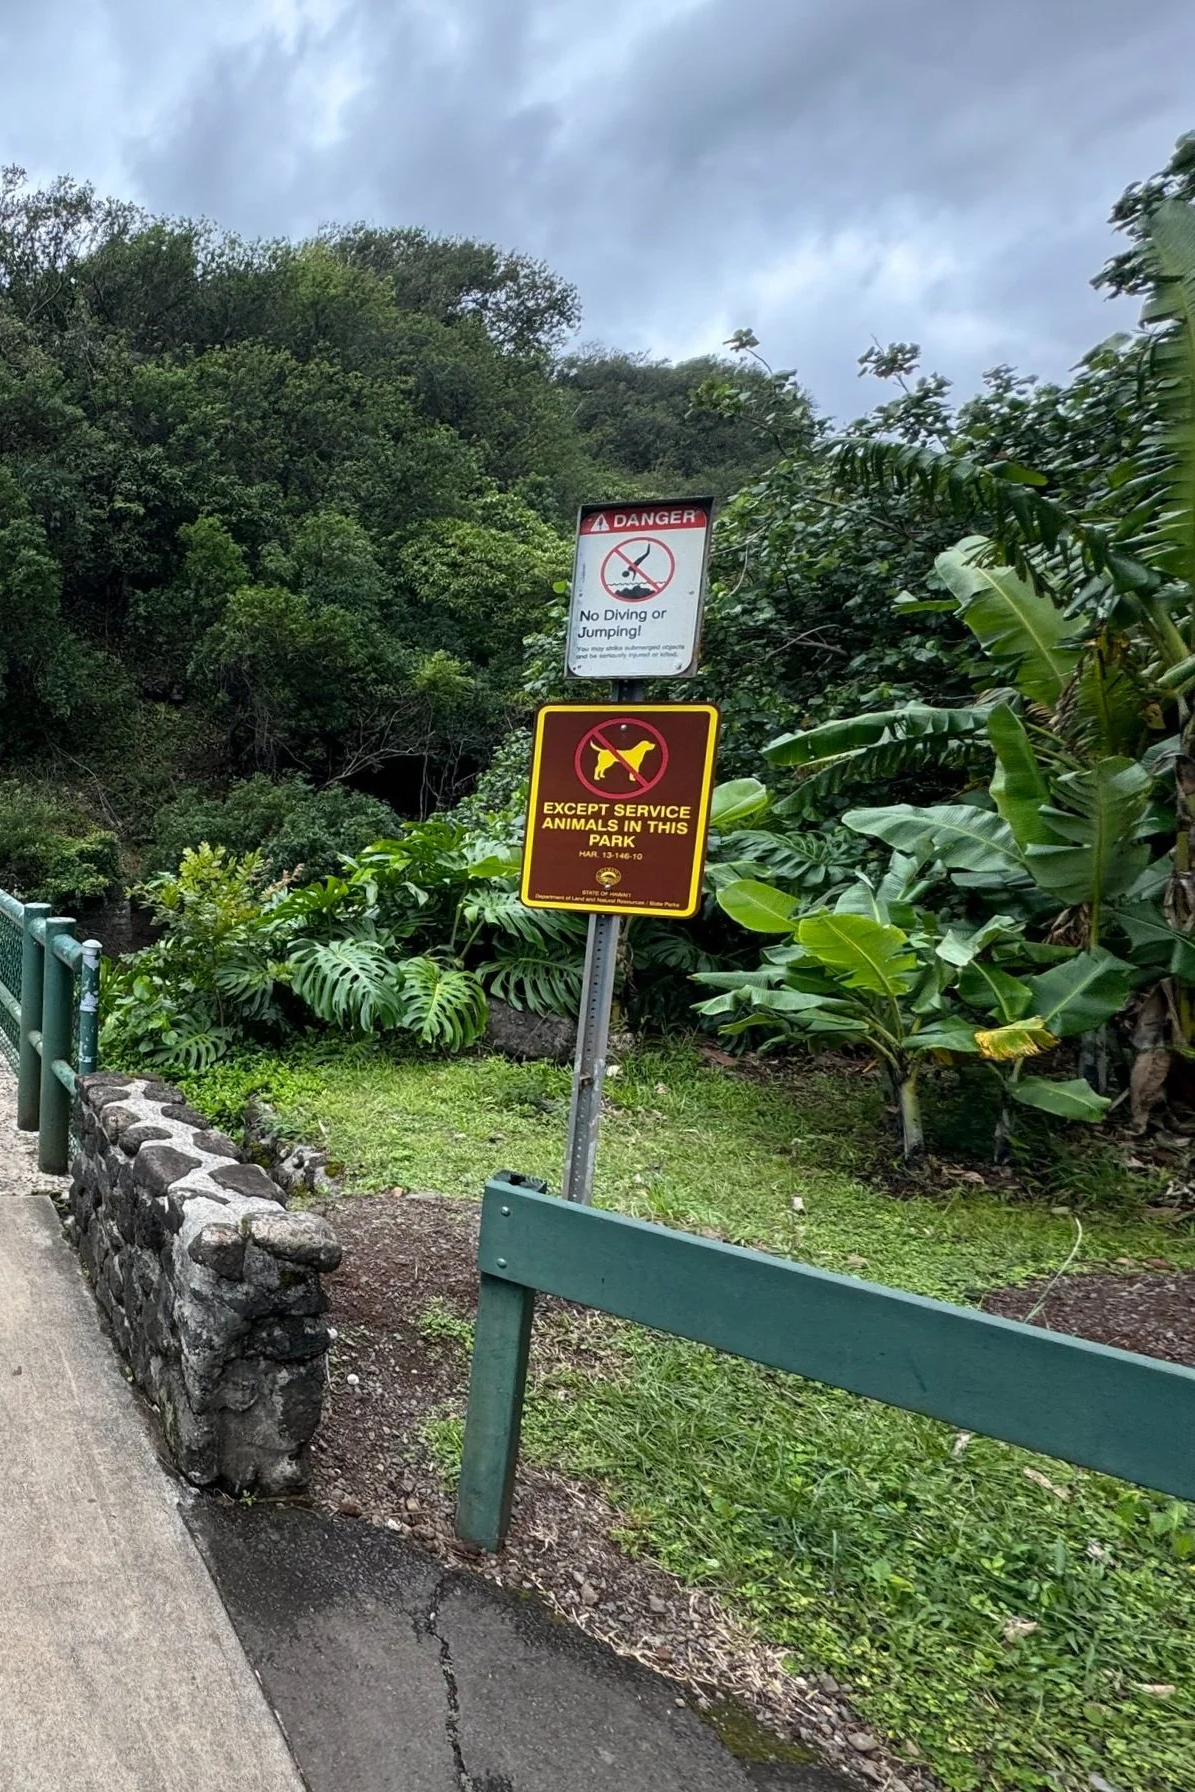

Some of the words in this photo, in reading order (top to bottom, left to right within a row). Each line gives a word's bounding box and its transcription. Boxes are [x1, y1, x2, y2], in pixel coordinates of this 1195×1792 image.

[613, 510, 696, 528] DANGER
[580, 610, 600, 621] No
[604, 609, 647, 622] Diving
[652, 609, 667, 619] or
[578, 625, 642, 640] Jumping!
[625, 644, 660, 652] submerged
[543, 802, 610, 816] EXCEPT
[613, 803, 691, 819] SERVICE
[542, 817, 619, 832] ANIMALS
[623, 820, 642, 833] IN
[647, 821, 689, 835] THIS
[589, 834, 636, 848] PARK
[578, 850, 599, 858] HAR.
[602, 851, 643, 860] 13-146-10
[535, 893, 567, 901] Department
[616, 898, 644, 906] Resources
